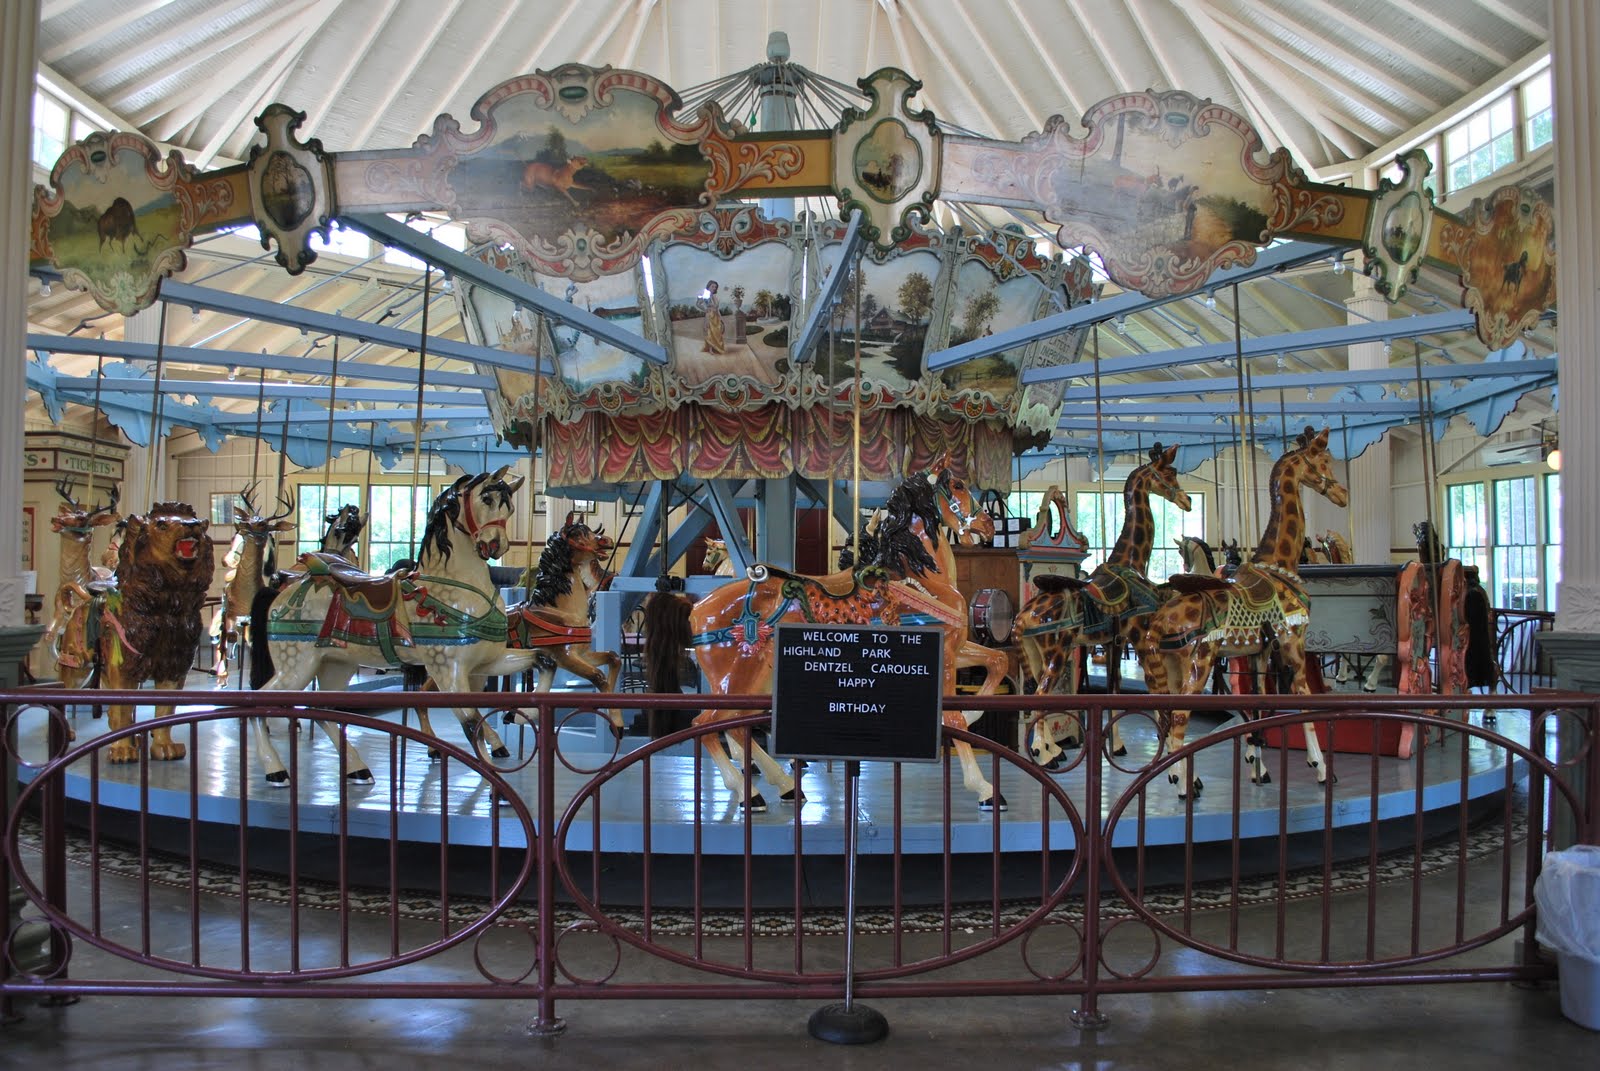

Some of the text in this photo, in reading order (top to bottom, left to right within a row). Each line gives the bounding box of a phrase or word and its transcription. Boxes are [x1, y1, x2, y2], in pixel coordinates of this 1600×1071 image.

[803, 632, 921, 644] WELCOME TO THE
[784, 646, 891, 658] HIGHLAND PARK
[805, 662, 929, 674] DENTZEL CAROUSEL
[839, 678, 875, 687] HAPPY
[830, 703, 885, 713] BIRTHDAY
